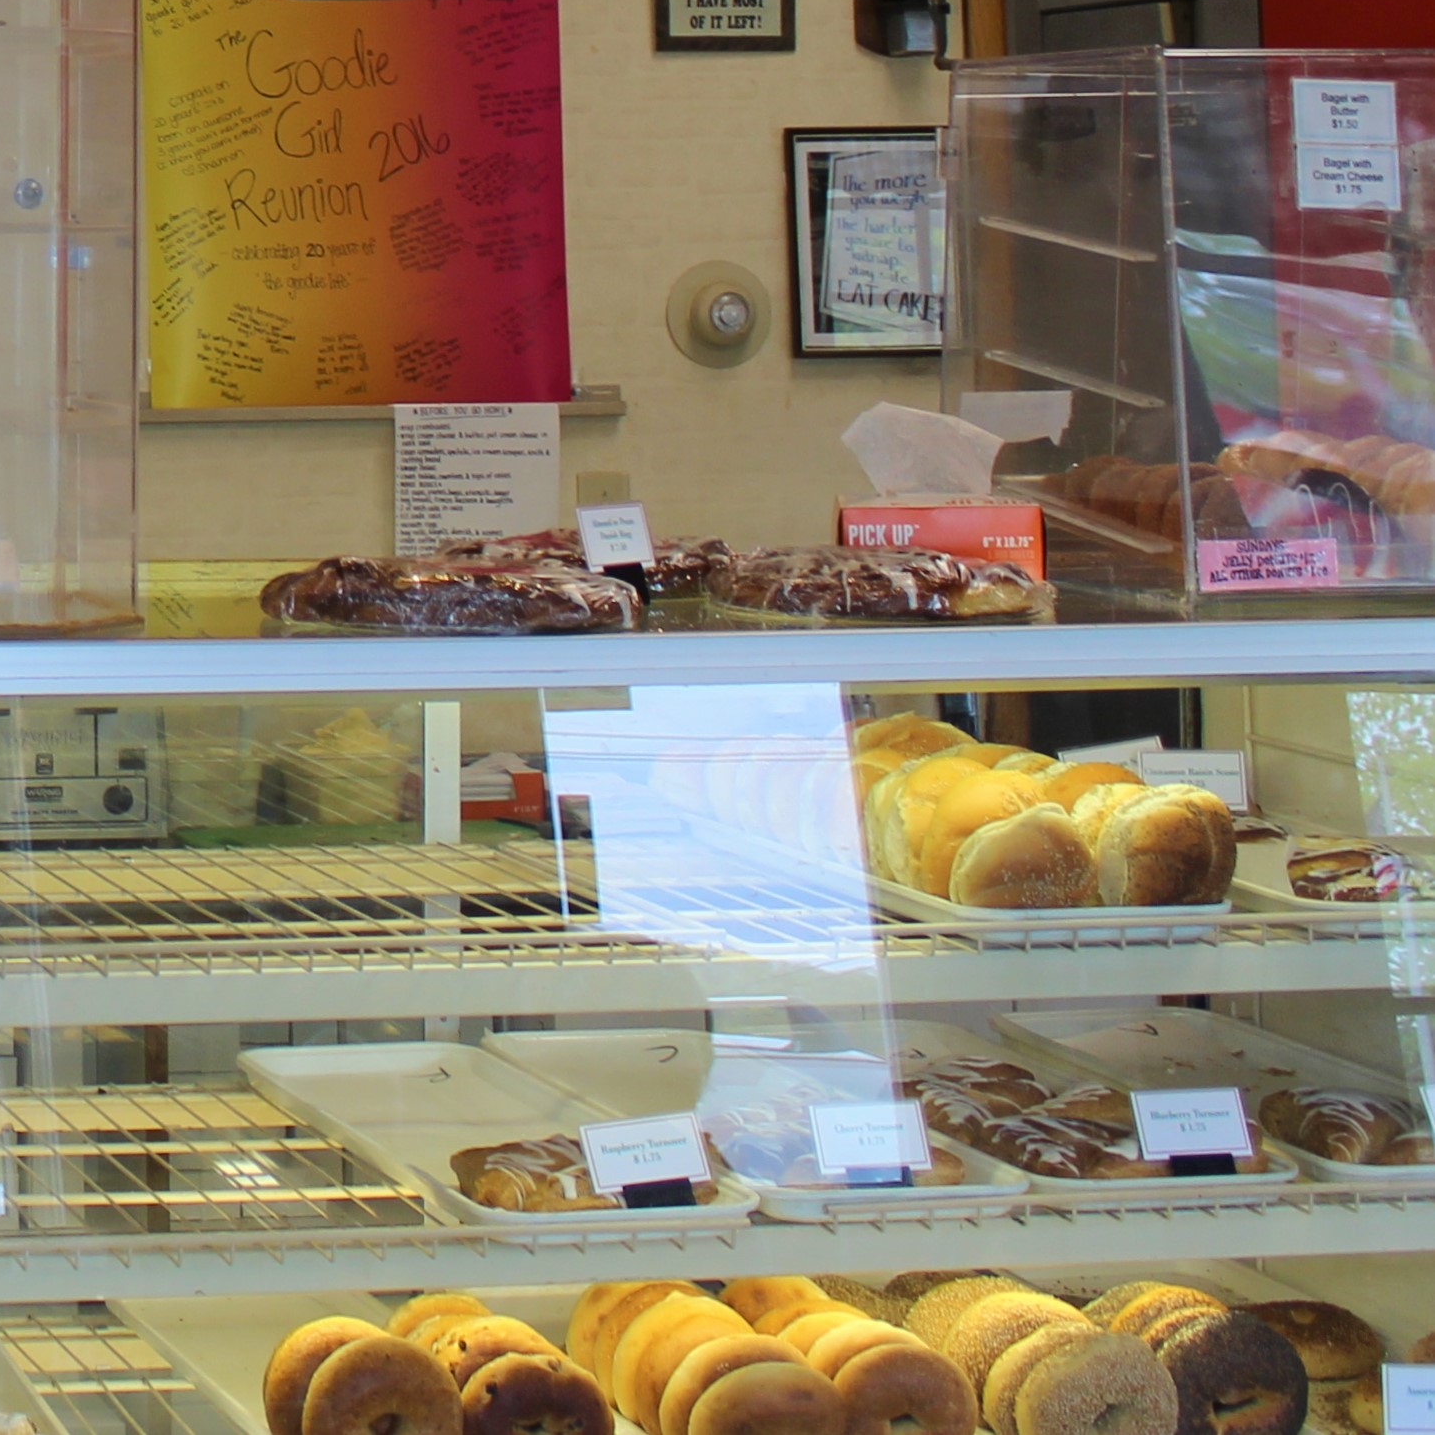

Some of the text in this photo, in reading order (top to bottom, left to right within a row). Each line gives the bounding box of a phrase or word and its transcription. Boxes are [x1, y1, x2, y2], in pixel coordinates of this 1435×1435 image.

[690, 15, 761, 29] OF IT LEFT!
[216, 30, 246, 51] The
[246, 28, 398, 98] Goodie
[1321, 93, 1369, 104] Bagel with
[1330, 106, 1359, 115] Butter
[274, 101, 343, 158] Girl
[1332, 119, 1358, 129] $1.50
[1323, 158, 1372, 169] Bagel with
[875, 174, 927, 190] more
[1313, 170, 1383, 182] Cream Cheese
[1336, 184, 1362, 194] $1.75
[224, 168, 369, 231] Reunion
[305, 243, 325, 258] 20
[838, 279, 878, 307] EAT
[848, 524, 887, 546] PICK
[1222, 554, 1253, 568] JELLY
[1210, 567, 1264, 583] ALL OTHER
[600, 1136, 688, 1156] Raspberry Turnover
